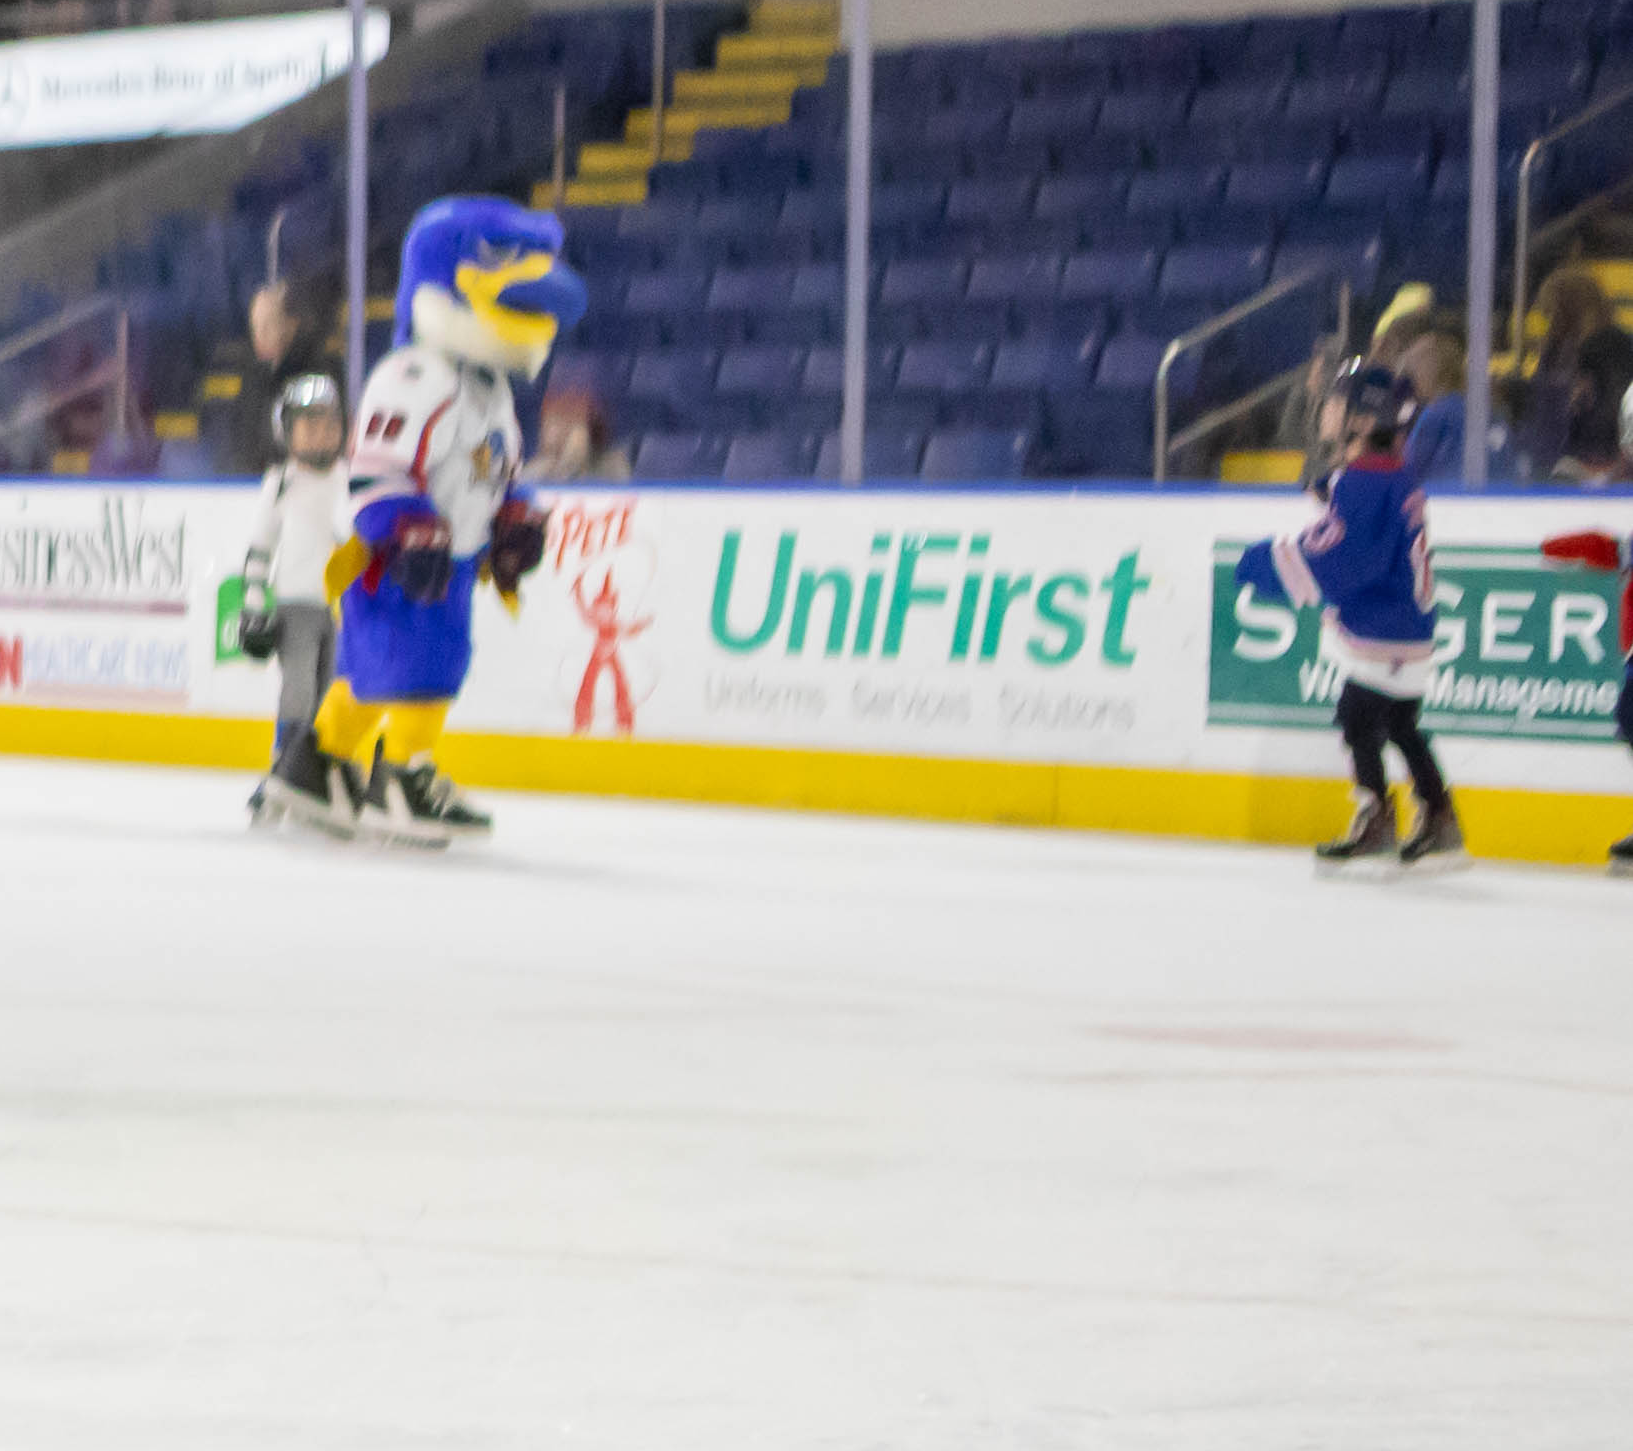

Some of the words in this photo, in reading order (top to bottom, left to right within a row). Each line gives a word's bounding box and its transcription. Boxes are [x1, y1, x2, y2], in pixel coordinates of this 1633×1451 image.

[709, 529, 1152, 668] UniFirst
[1232, 581, 1610, 665] SGER
[1424, 665, 1618, 722] Manageme
